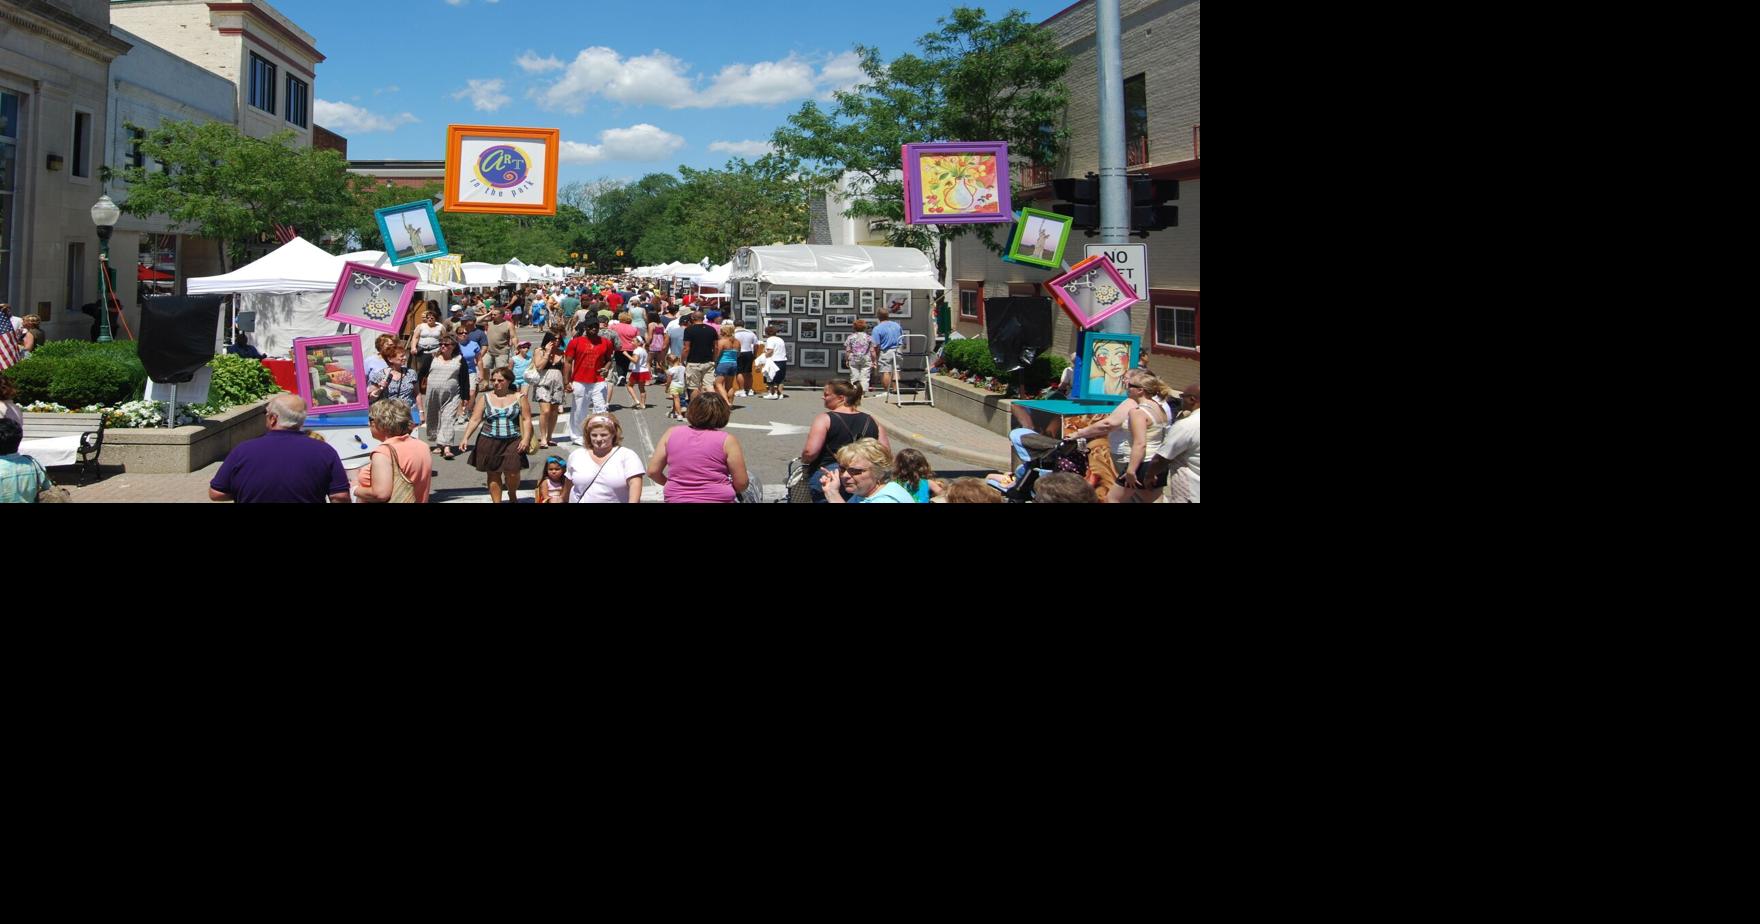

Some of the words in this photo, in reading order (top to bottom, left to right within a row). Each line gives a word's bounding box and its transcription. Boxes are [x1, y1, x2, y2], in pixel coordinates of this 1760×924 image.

[484, 187, 503, 197] the
[511, 180, 534, 197] park
[1104, 251, 1128, 263] NO
